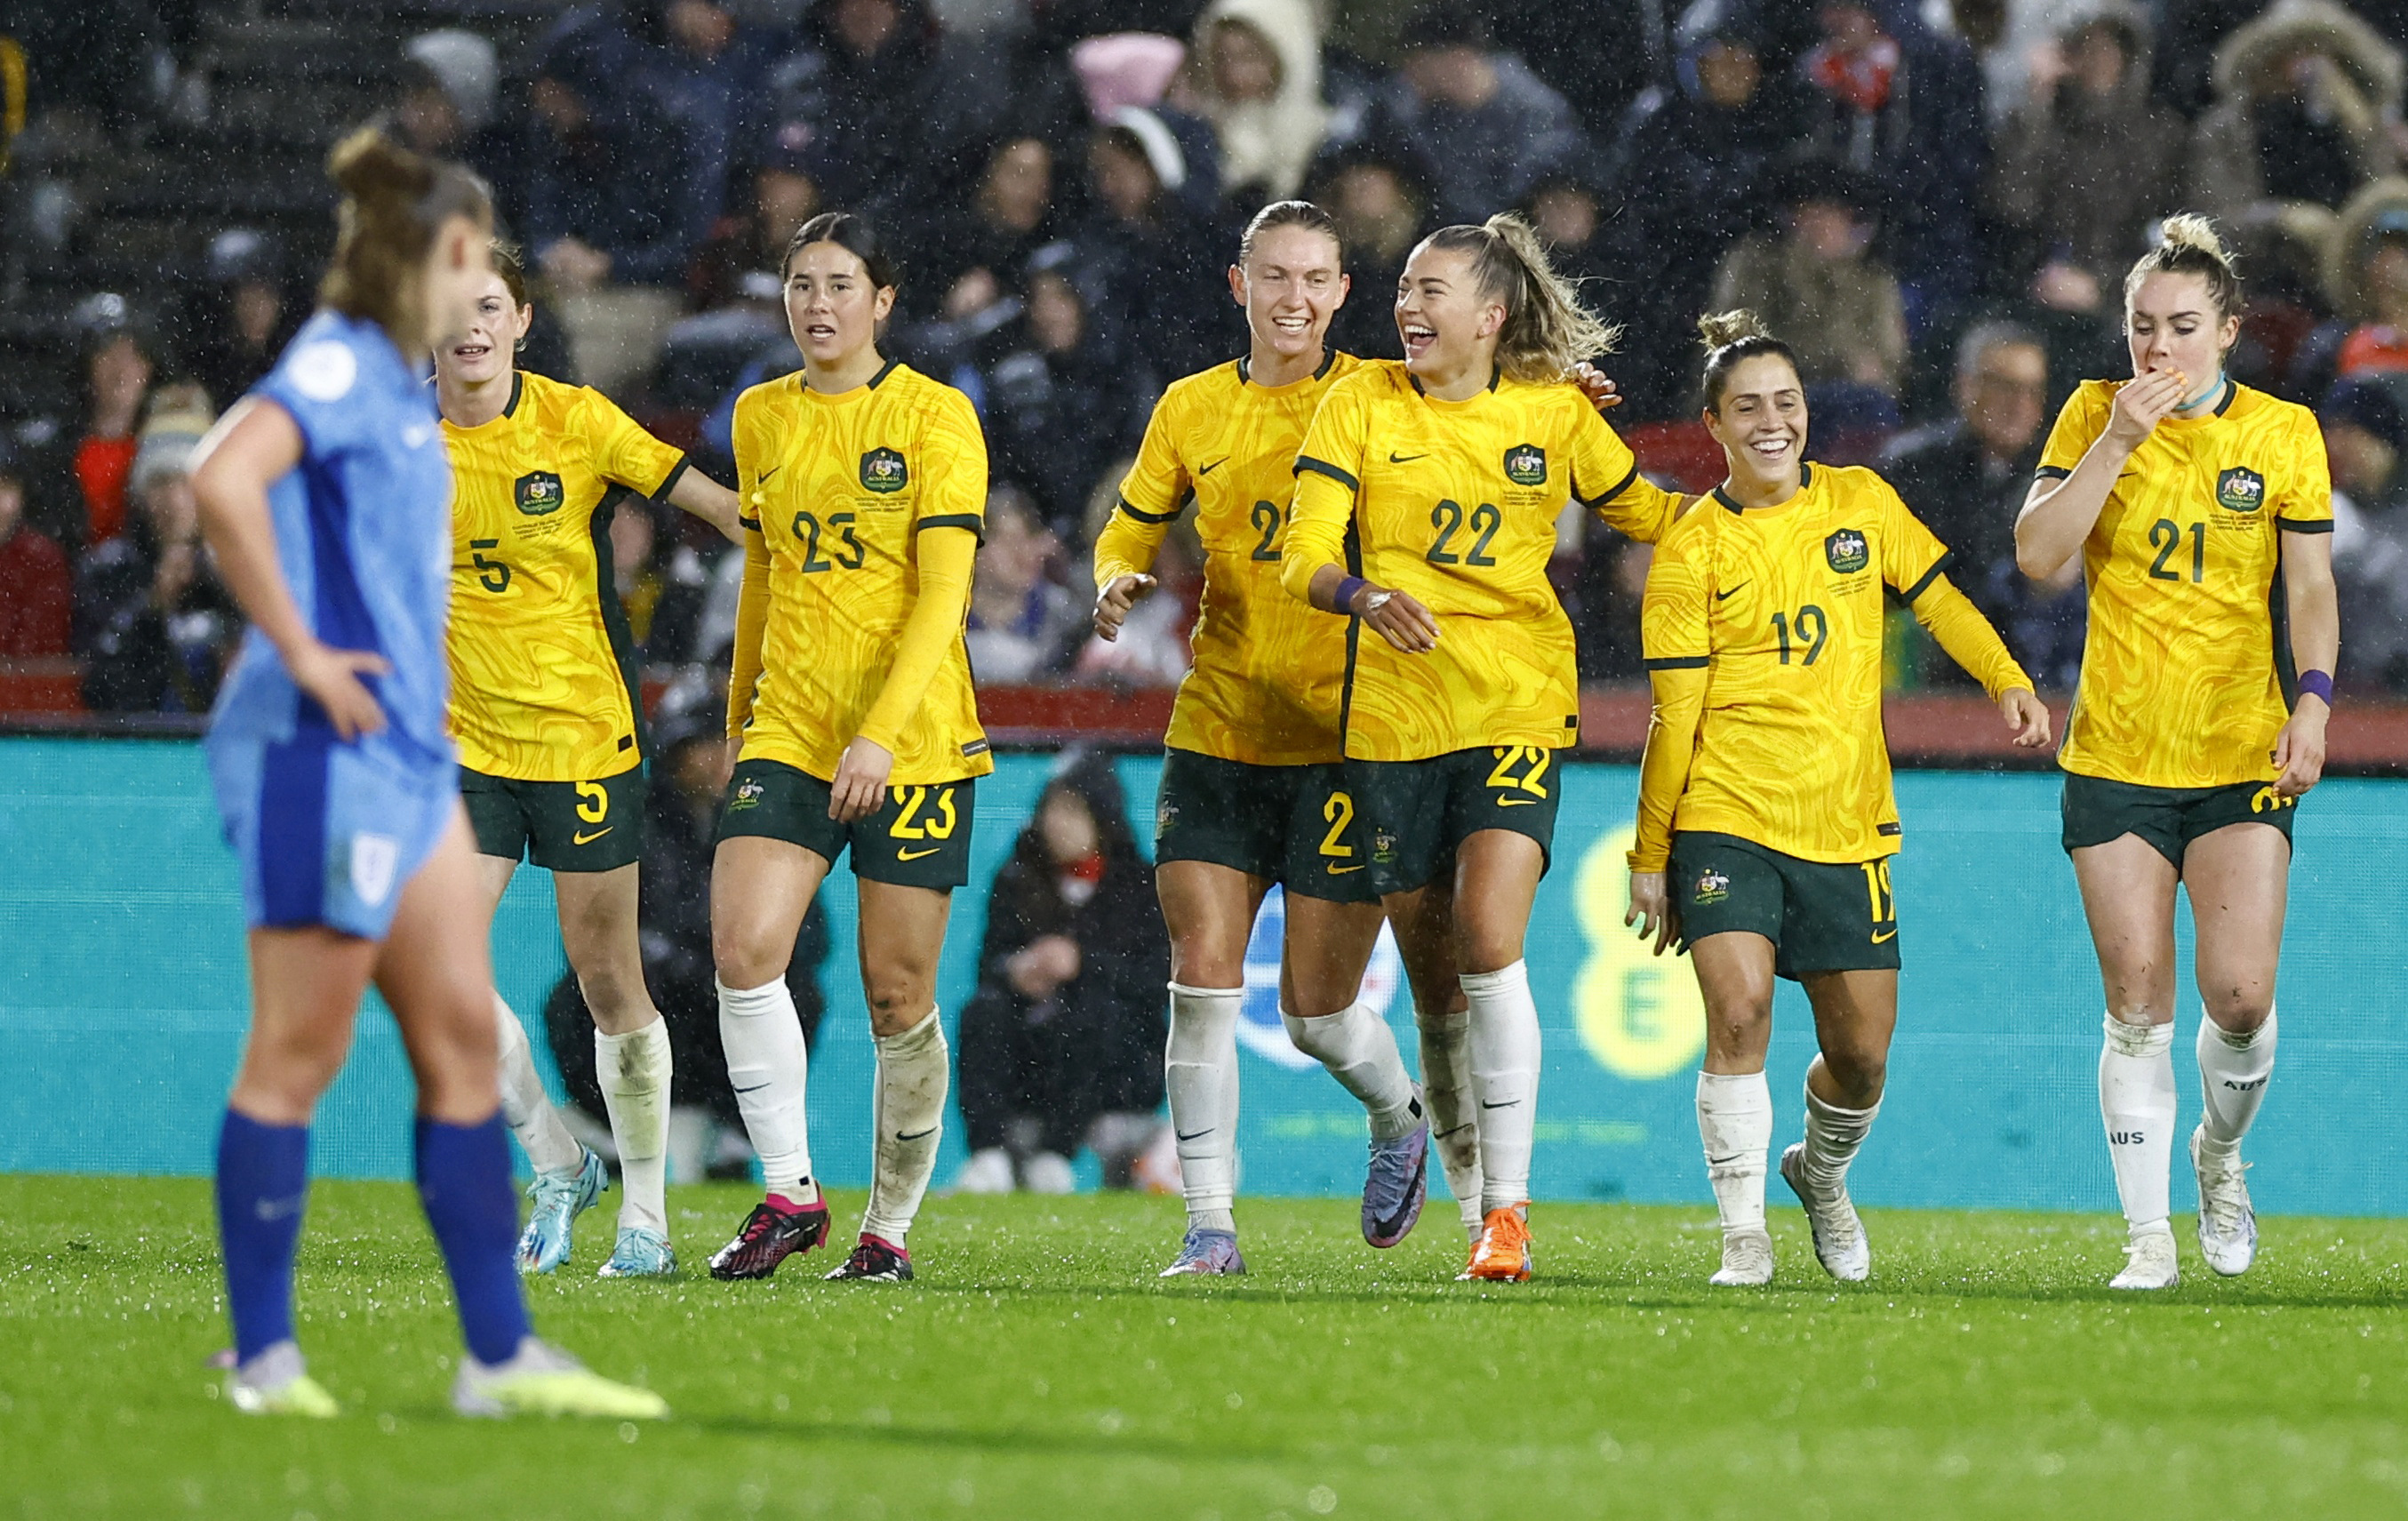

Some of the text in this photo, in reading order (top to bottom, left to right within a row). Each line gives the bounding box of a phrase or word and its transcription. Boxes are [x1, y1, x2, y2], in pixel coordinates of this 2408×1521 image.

[792, 510, 865, 573] 23
[1252, 498, 1293, 561] 2
[1426, 498, 1501, 566] 22
[2148, 518, 2205, 583] 21
[469, 539, 511, 593] 5
[1771, 604, 1828, 666] 19
[575, 781, 608, 823] 5
[1485, 745, 1550, 799] 22
[890, 785, 956, 839] 23
[1319, 791, 1354, 857] 2
